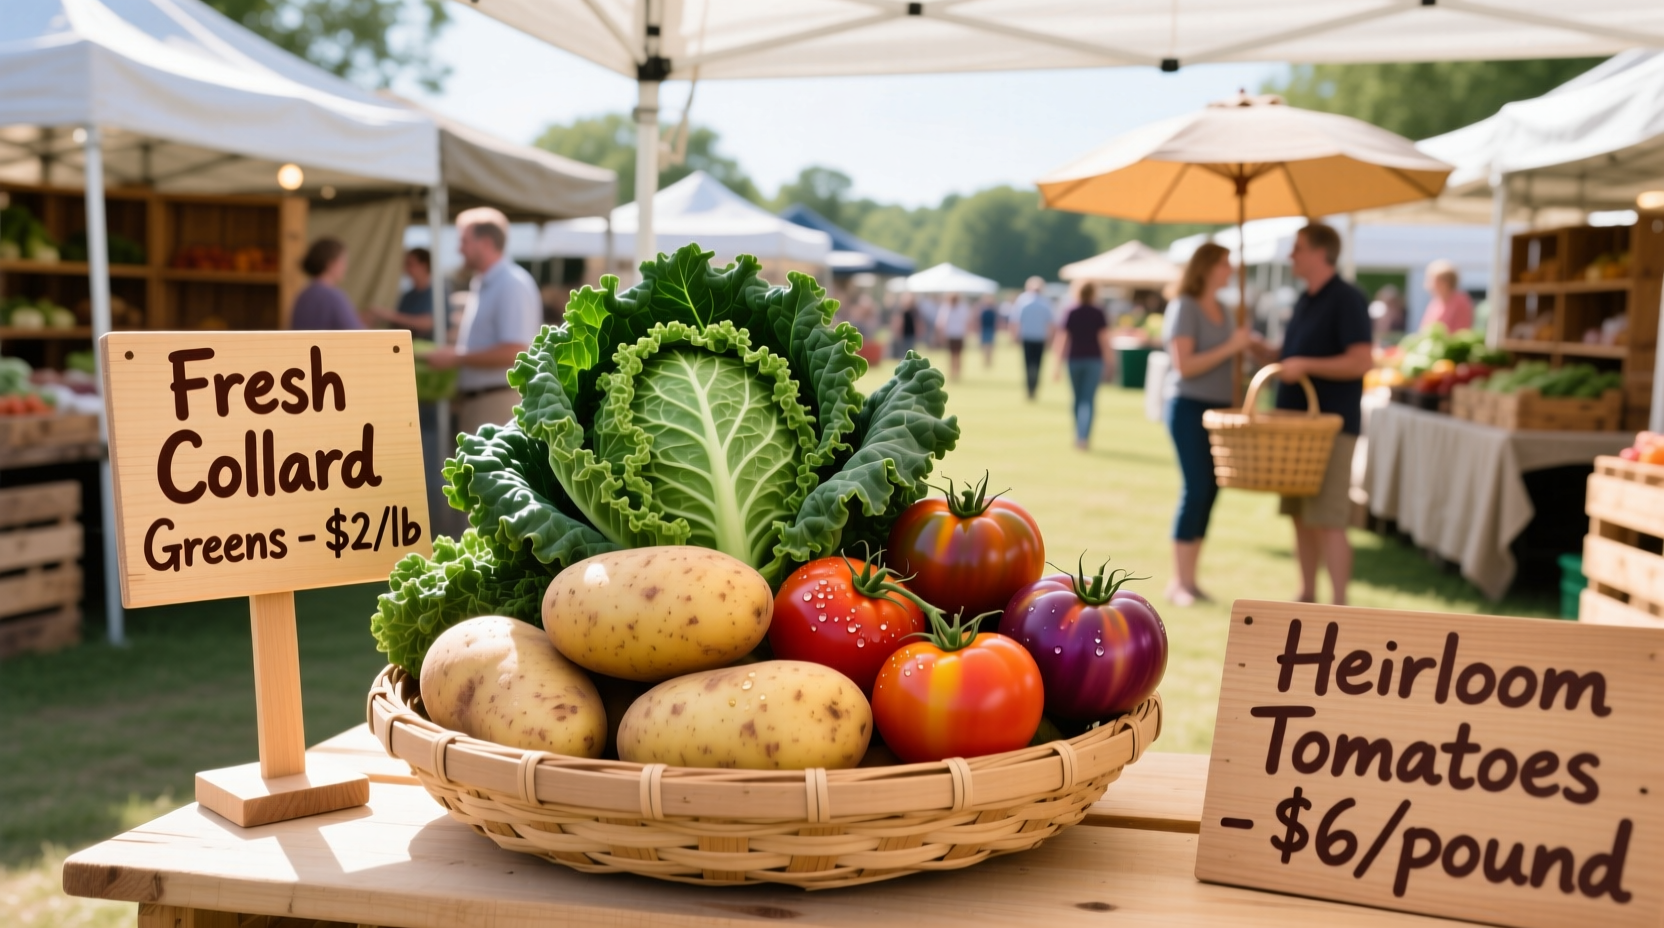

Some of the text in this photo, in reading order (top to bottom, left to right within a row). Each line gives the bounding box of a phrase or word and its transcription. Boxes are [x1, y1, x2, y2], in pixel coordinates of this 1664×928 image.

[168, 345, 346, 421] Fresh
[157, 423, 382, 505] Collard
[144, 505, 422, 572] Greens - $2/lb
[1276, 618, 1612, 718] Heirloom
[1250, 705, 1601, 805] Tomatoes
[1220, 786, 1634, 905] - $6/pound
